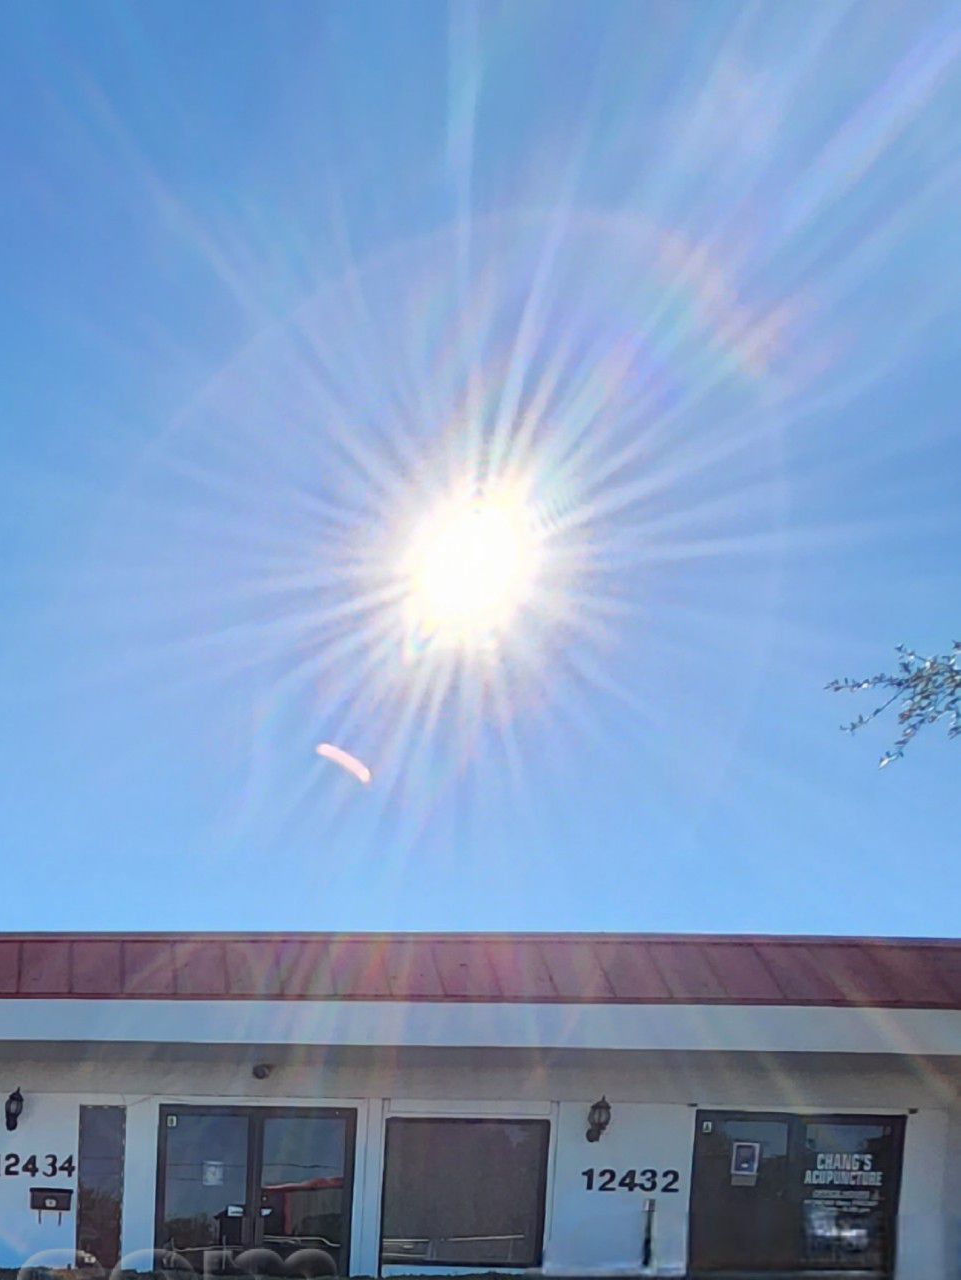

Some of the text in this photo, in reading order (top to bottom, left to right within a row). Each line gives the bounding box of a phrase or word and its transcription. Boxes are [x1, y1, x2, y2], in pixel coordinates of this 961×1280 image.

[817, 1153, 873, 1171] CHANG'S
[581, 1168, 680, 1193] 12432
[803, 1169, 883, 1186] ACUPUNCTURE
